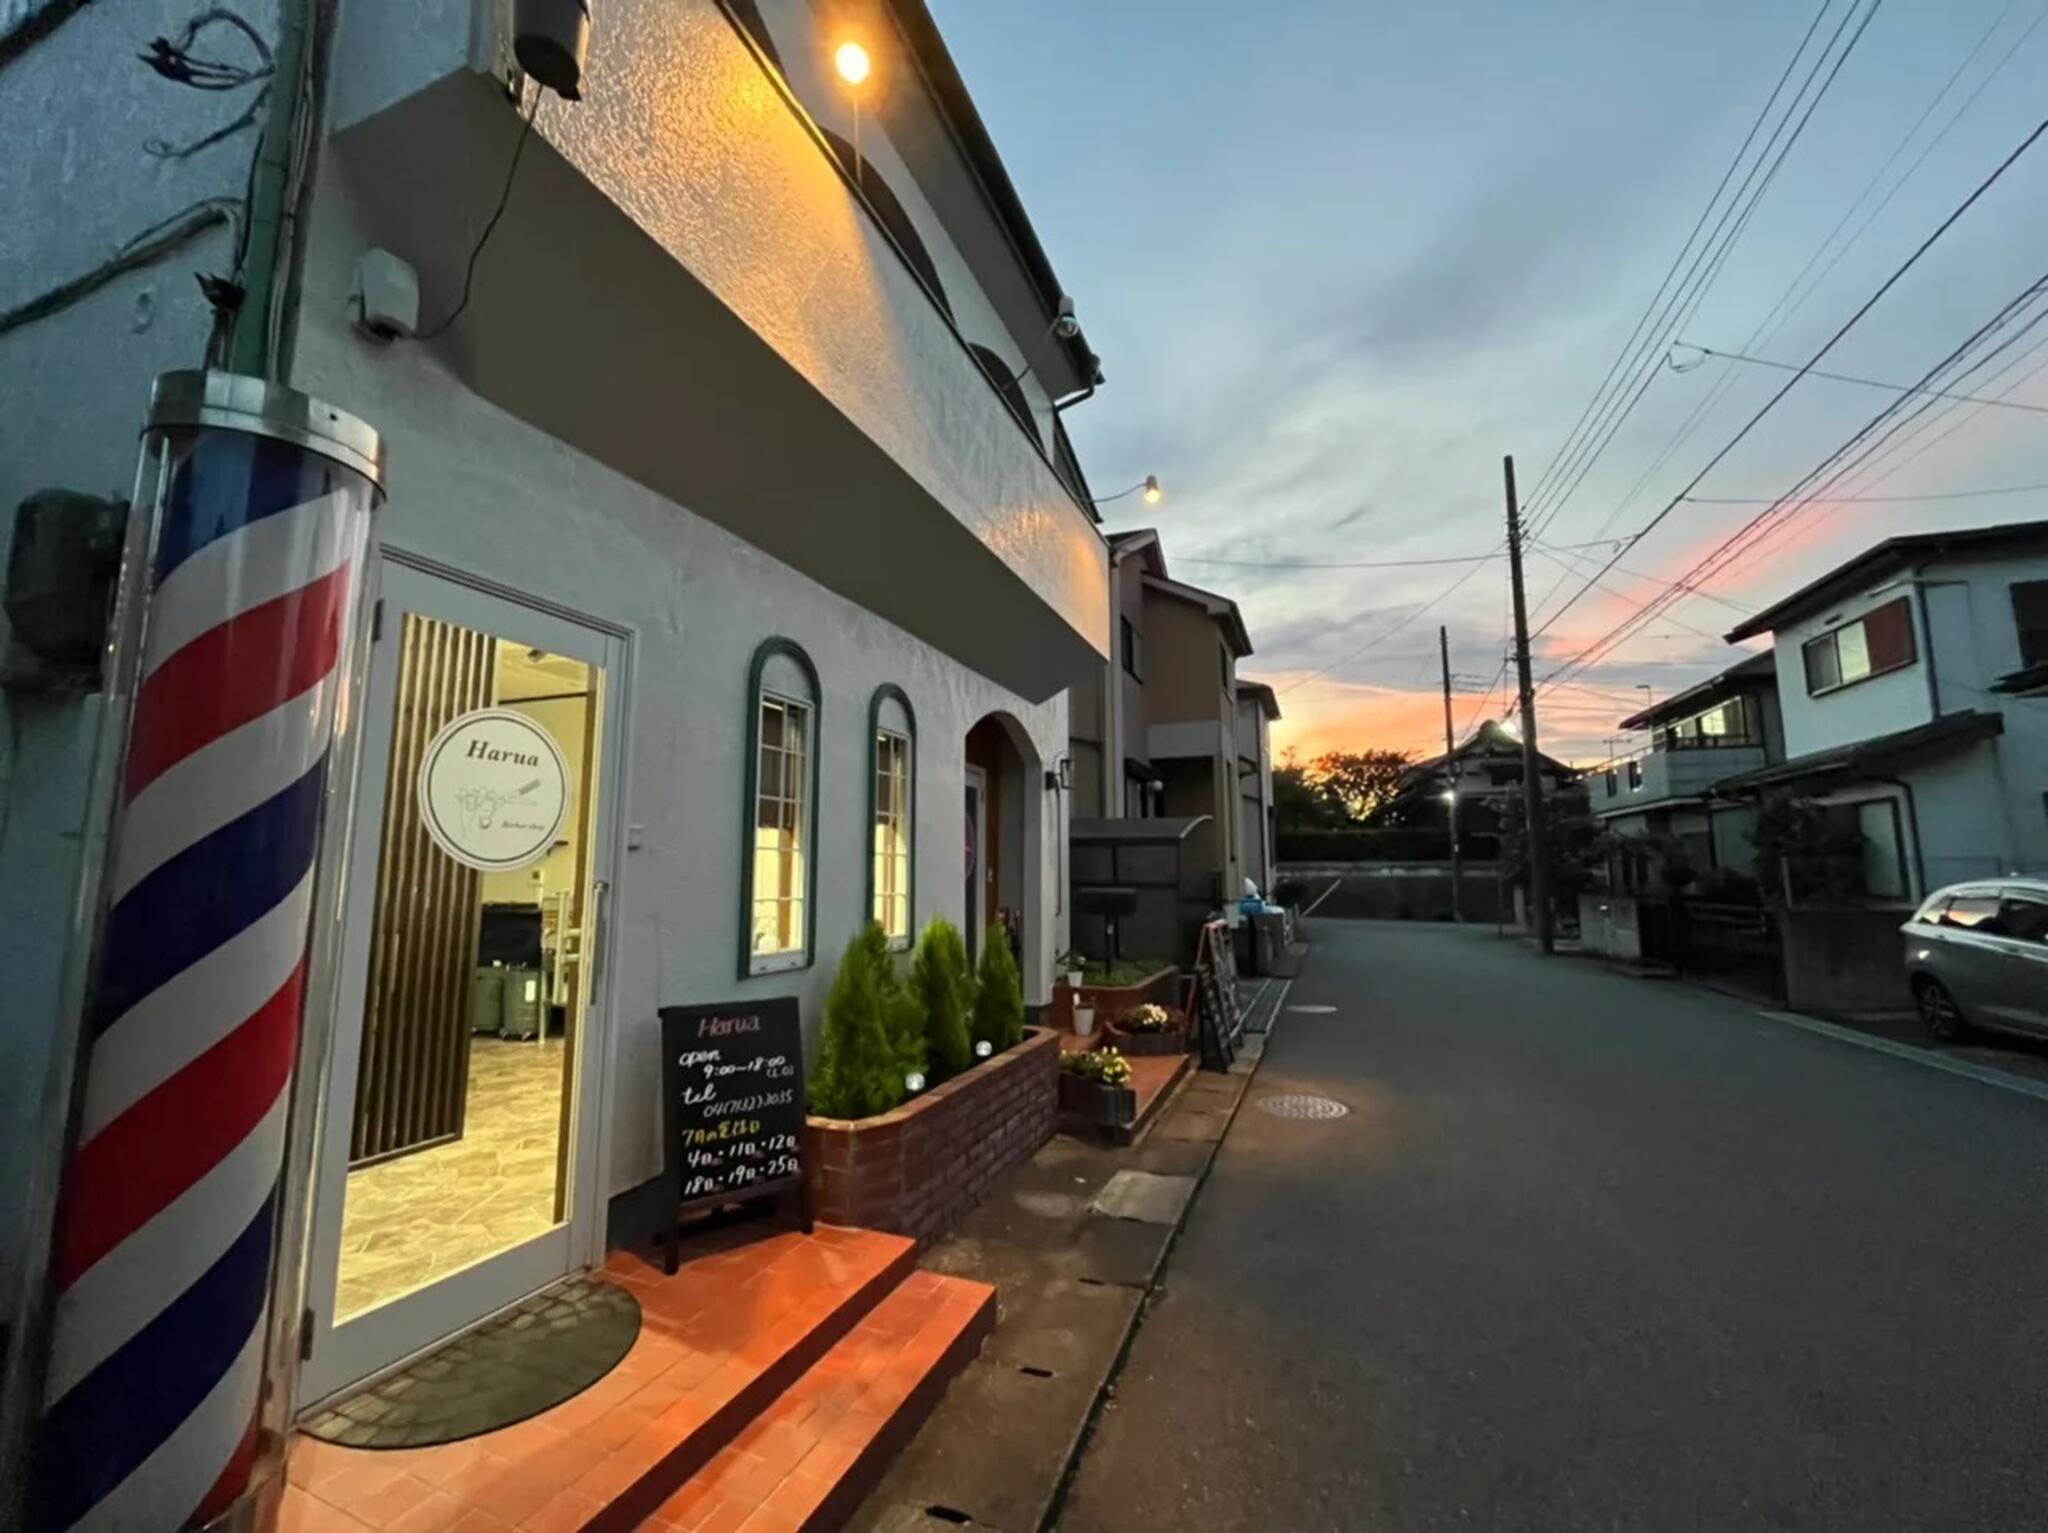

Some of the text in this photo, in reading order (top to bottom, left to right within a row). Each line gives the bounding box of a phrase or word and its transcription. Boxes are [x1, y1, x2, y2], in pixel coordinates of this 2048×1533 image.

[466, 739, 539, 767] Harua
[697, 1015, 760, 1037] Harua
[679, 1049, 721, 1068] open
[681, 1082, 717, 1105] tel
